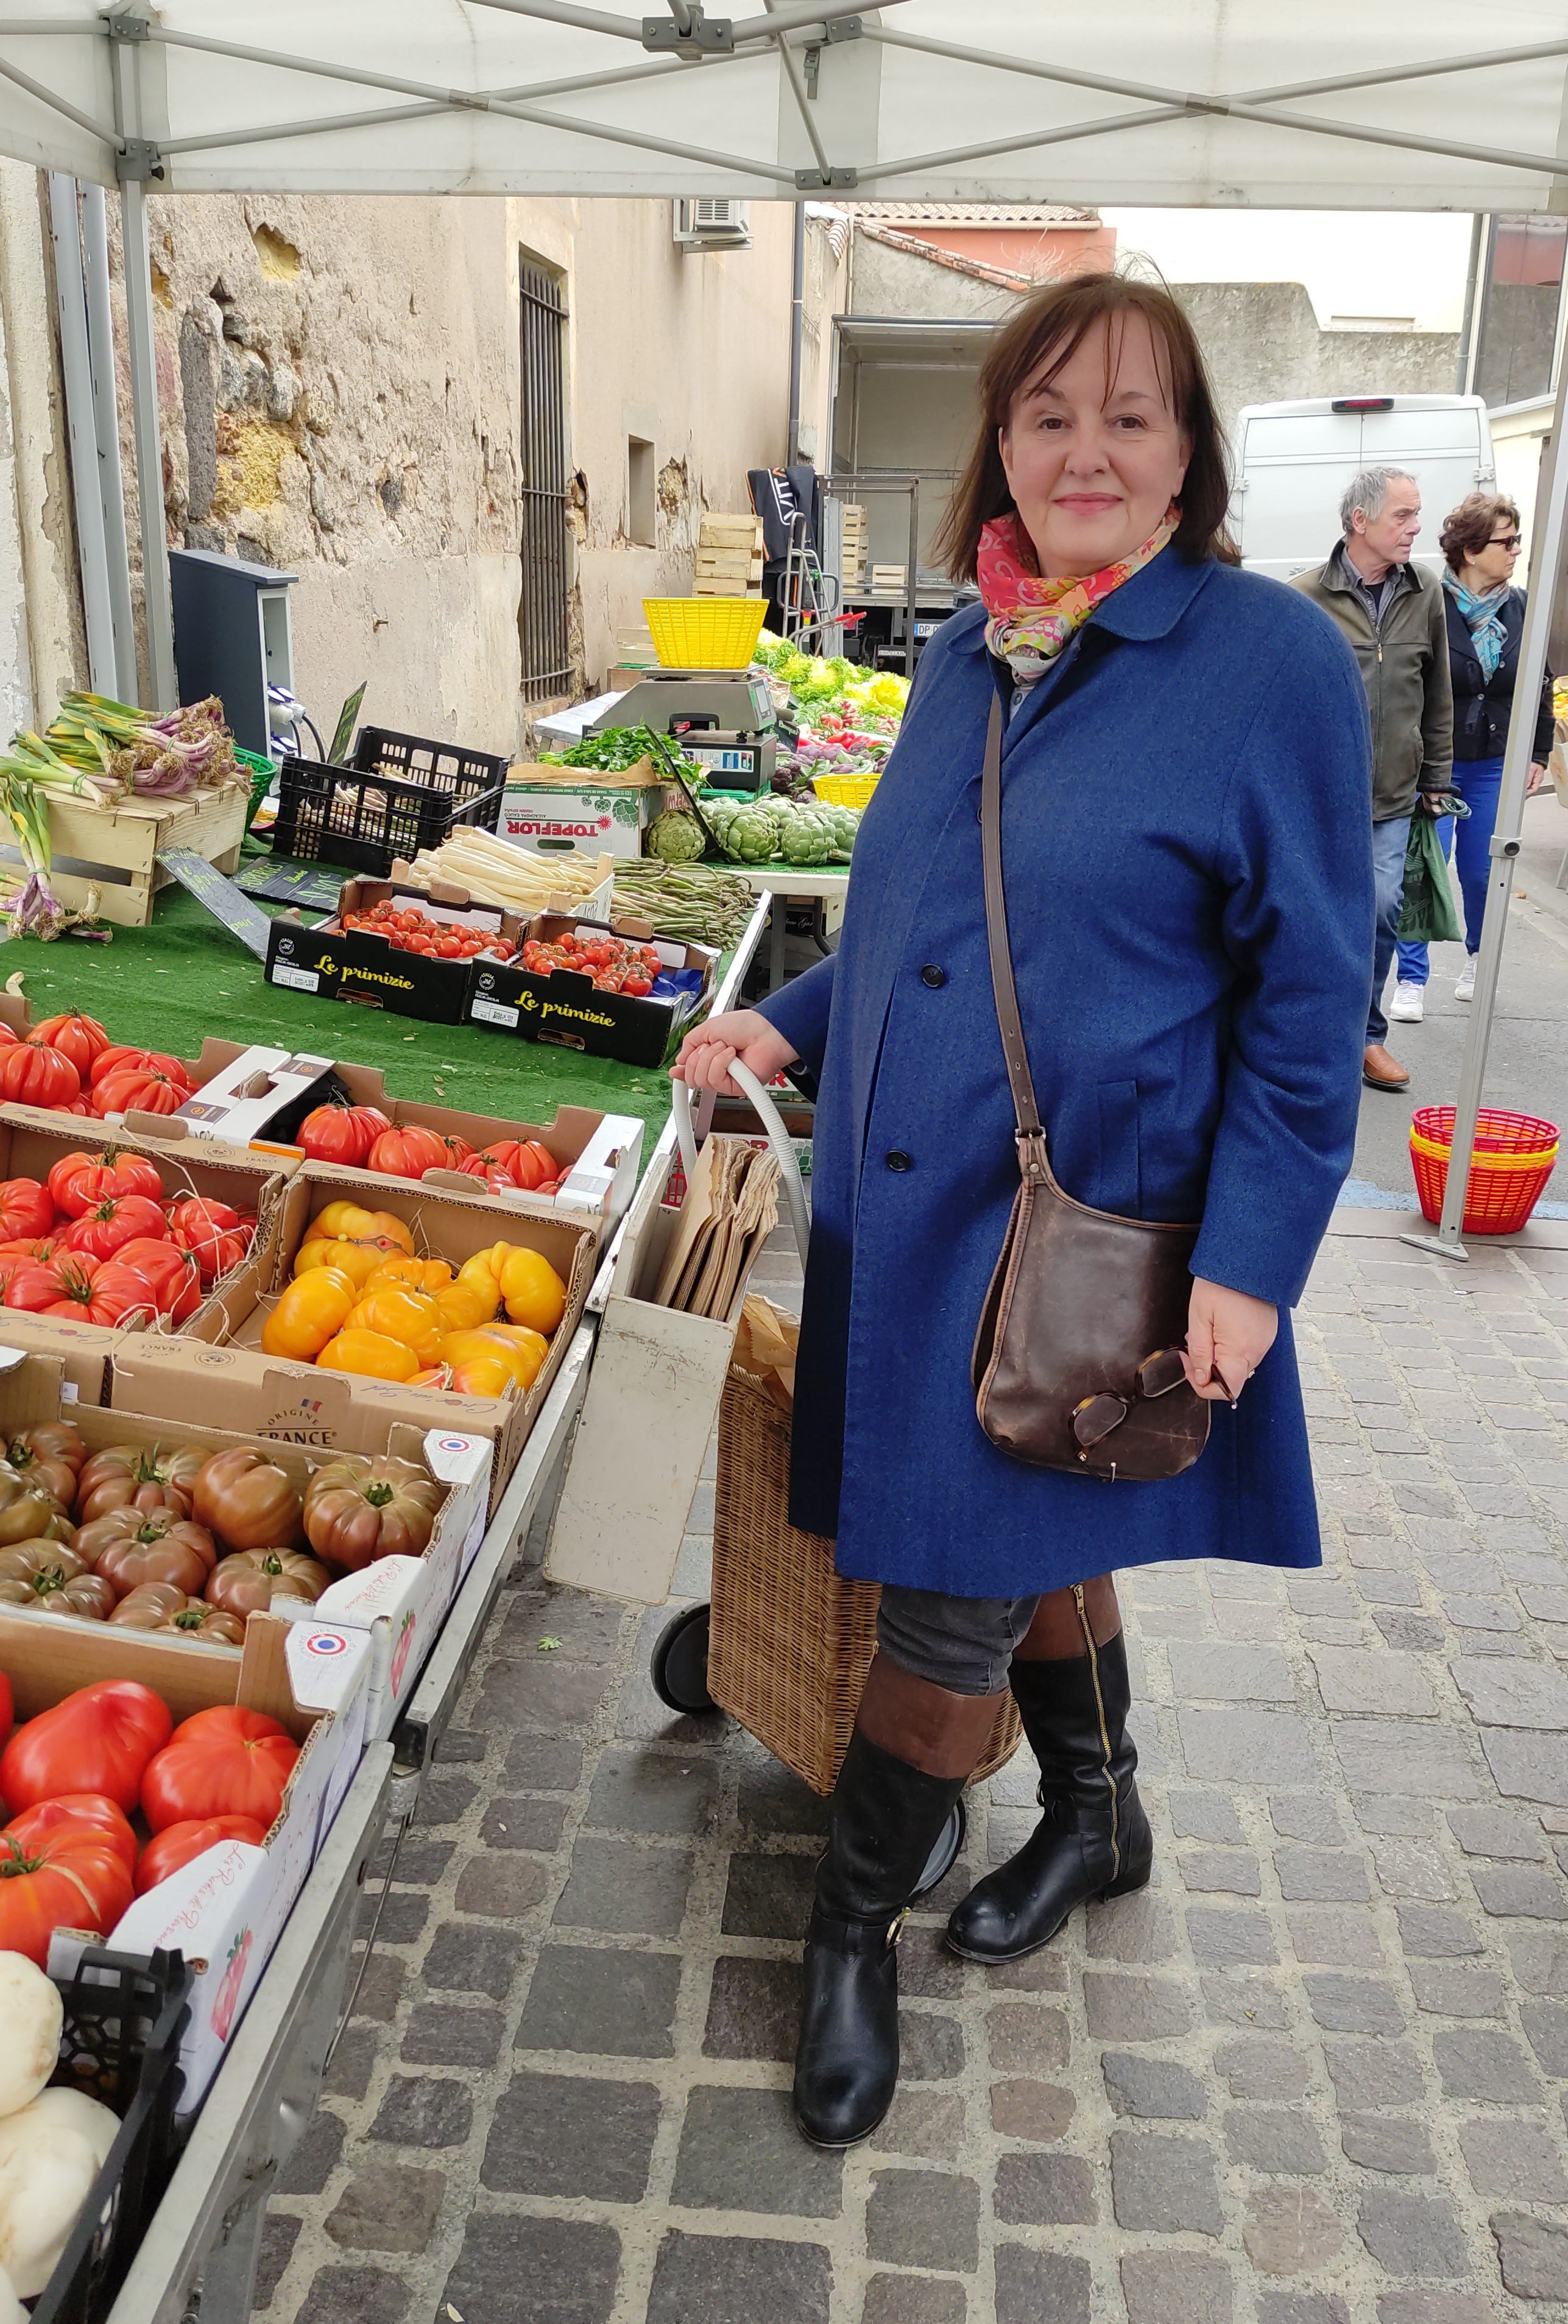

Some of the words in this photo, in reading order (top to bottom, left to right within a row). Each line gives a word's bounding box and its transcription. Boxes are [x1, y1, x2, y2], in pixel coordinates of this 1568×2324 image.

[507, 821, 599, 836] TOPEFLOR
[314, 955, 338, 975] Le
[341, 967, 415, 990] primizie
[514, 991, 539, 1011] Le
[540, 1002, 616, 1027] primizie
[267, 1409, 320, 1426] ORIGINE
